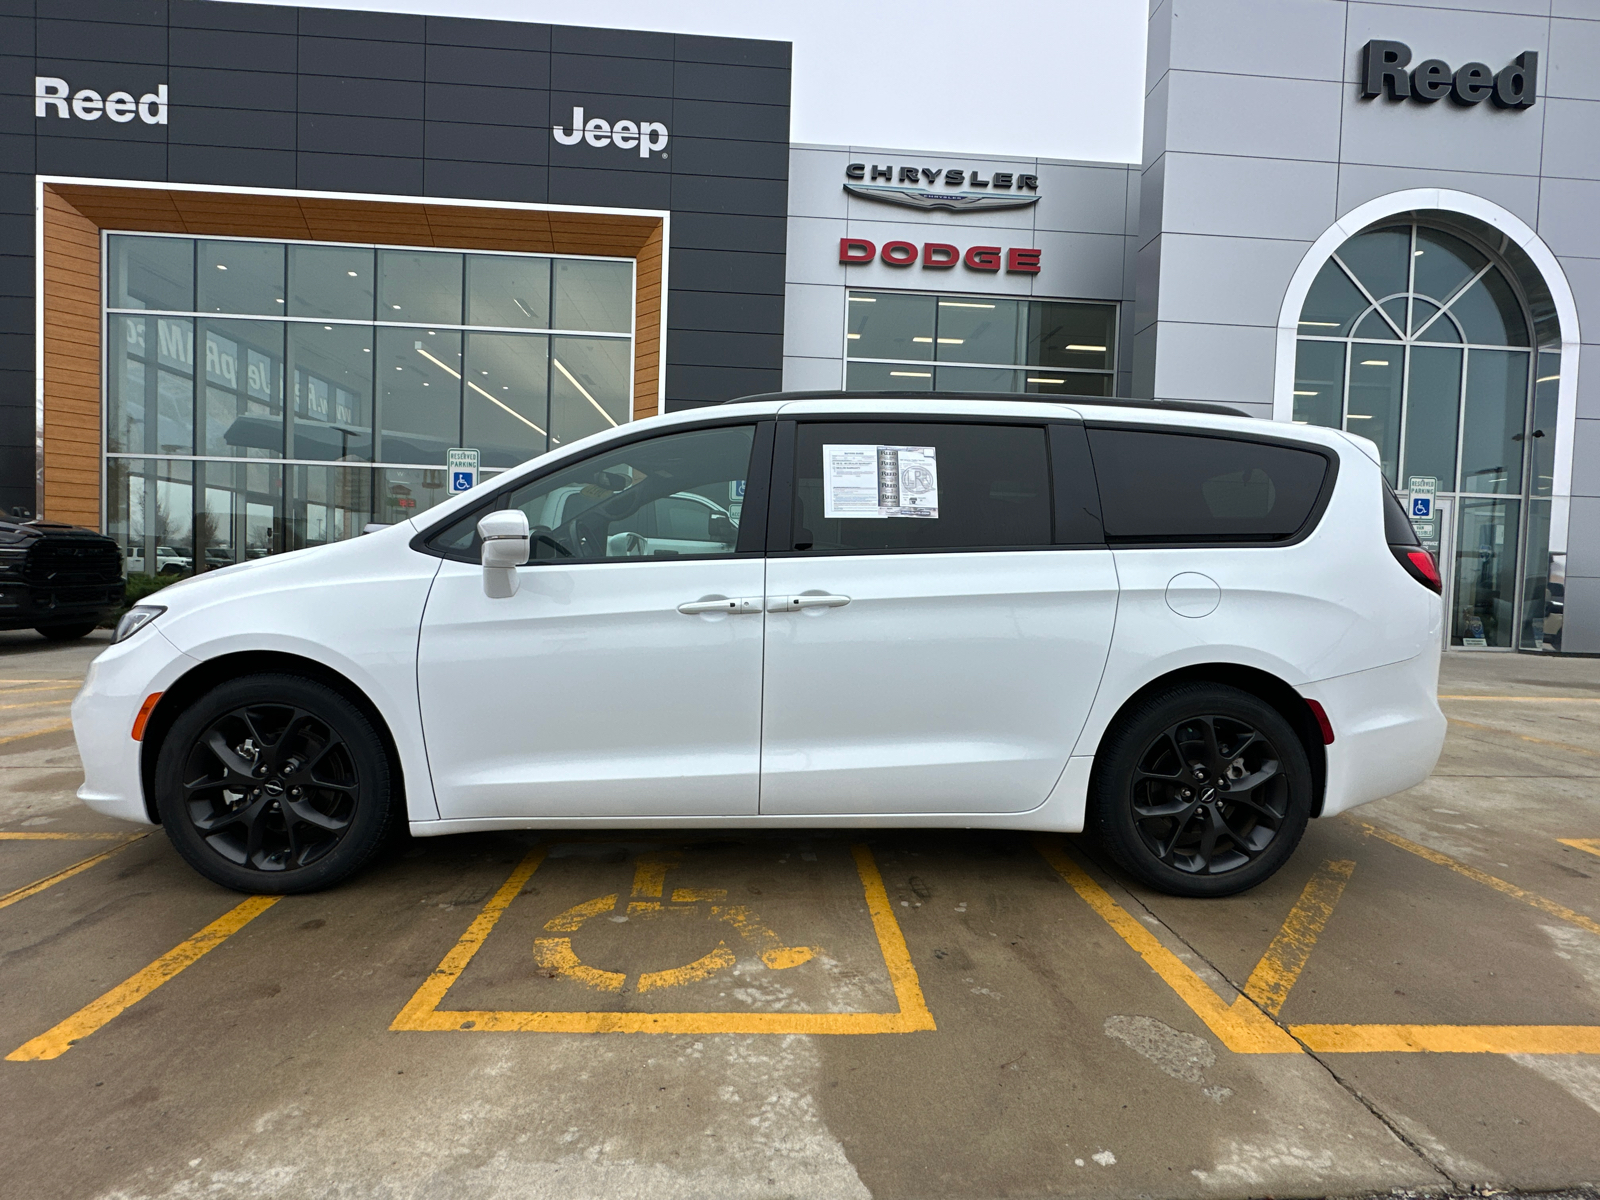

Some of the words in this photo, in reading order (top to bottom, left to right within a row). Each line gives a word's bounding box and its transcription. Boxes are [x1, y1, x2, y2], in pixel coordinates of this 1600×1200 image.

[1362, 39, 1538, 109] Reed
[35, 76, 169, 125] Reed
[553, 106, 669, 158] Jeep
[846, 163, 1039, 189] CHRYSLER
[839, 238, 1042, 274] DODGE
[1411, 480, 1434, 488] RESERVED
